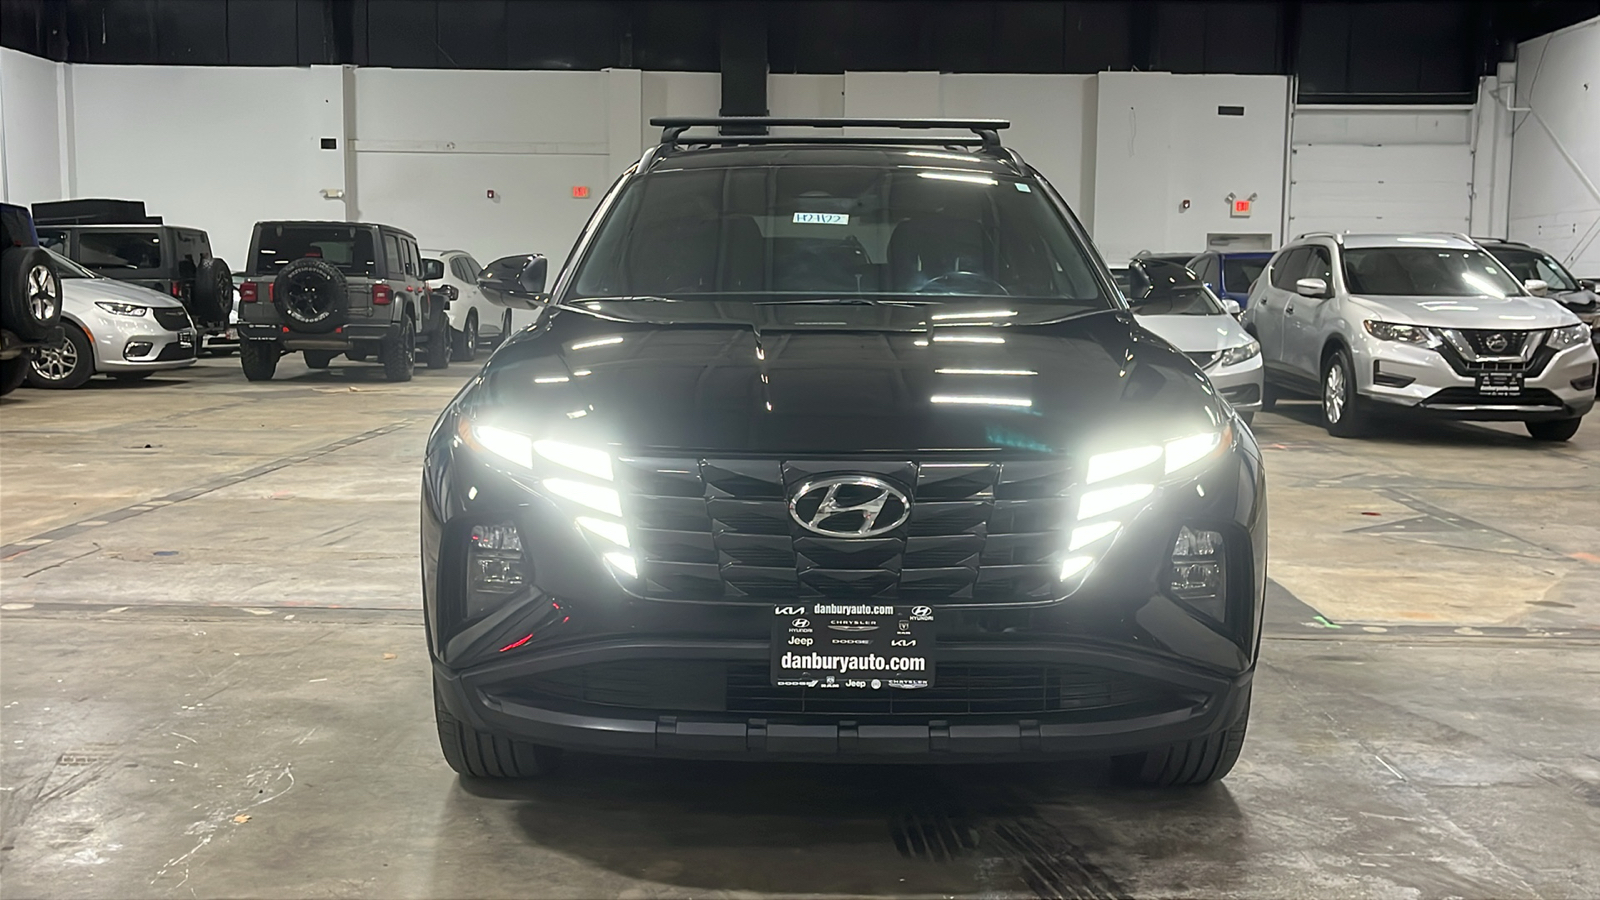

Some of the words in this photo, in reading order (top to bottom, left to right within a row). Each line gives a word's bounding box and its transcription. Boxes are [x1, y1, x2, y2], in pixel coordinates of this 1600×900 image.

[813, 603, 894, 616] danburyauto.com
[787, 636, 814, 647] Jeep
[781, 651, 926, 673] danburyauto.com
[845, 679, 866, 688] Jeep
